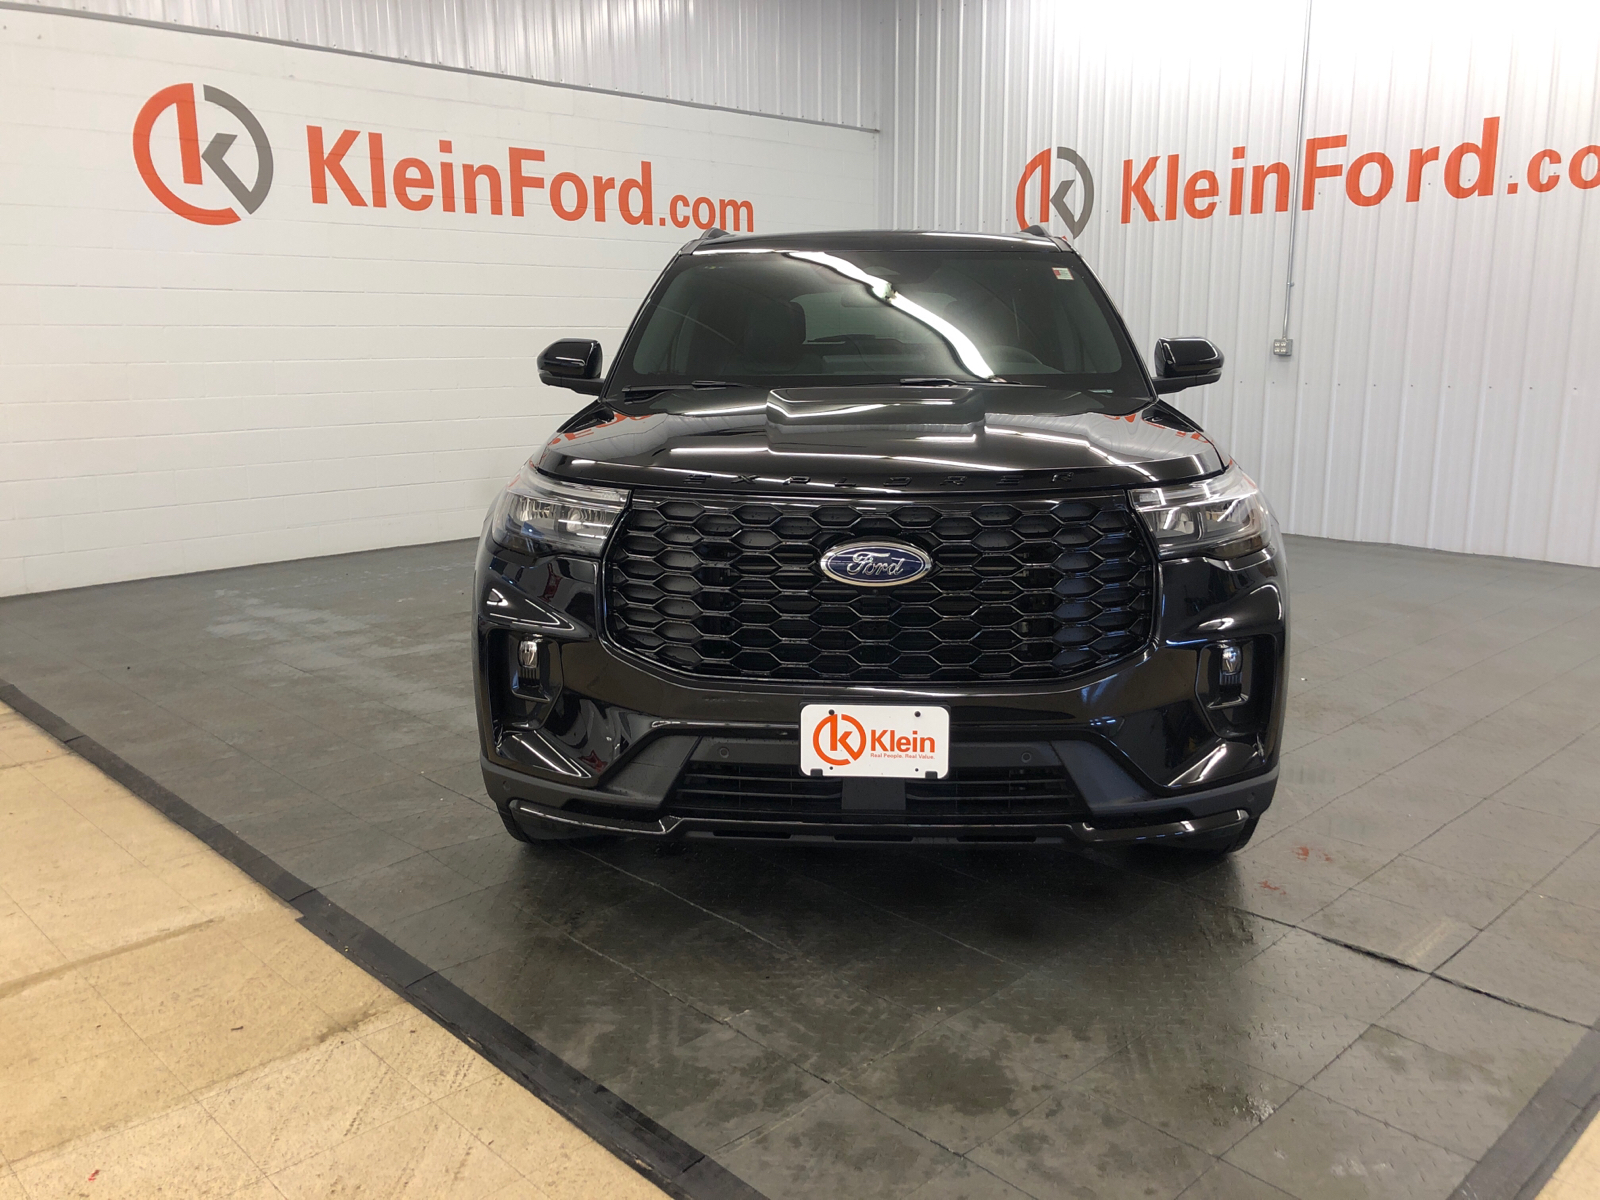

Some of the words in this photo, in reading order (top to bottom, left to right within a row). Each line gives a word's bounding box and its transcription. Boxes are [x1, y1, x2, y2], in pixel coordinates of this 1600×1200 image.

[306, 125, 755, 233] KleinFord.com
[682, 471, 1074, 488] EXPLORER
[846, 551, 905, 576] Ford
[870, 729, 936, 753] Klein
[883, 752, 904, 760] People.
